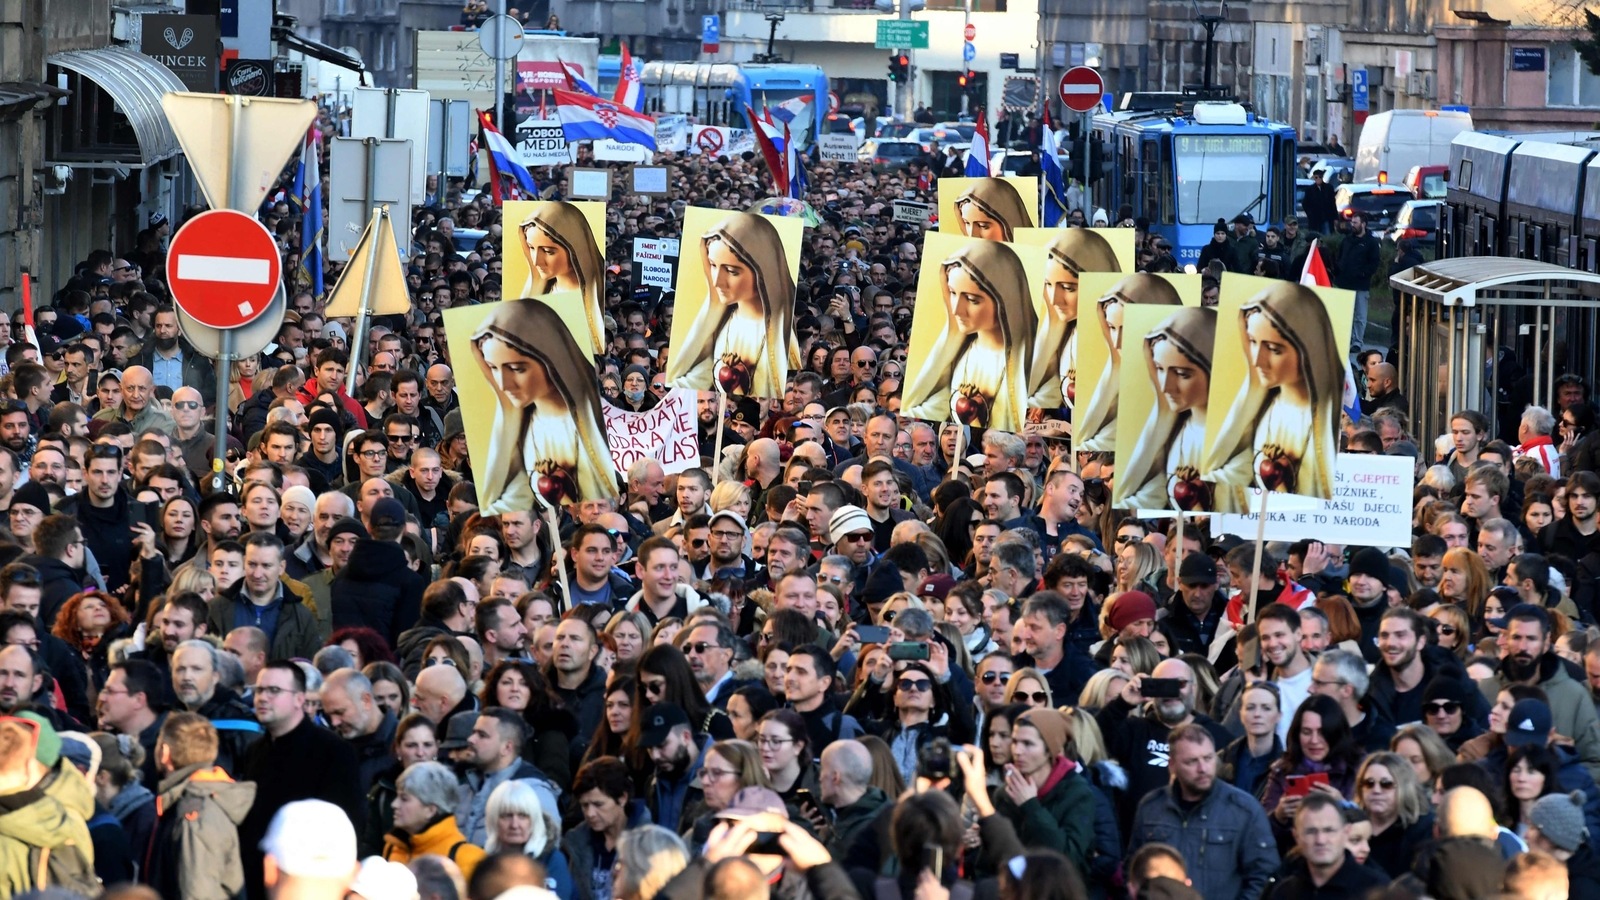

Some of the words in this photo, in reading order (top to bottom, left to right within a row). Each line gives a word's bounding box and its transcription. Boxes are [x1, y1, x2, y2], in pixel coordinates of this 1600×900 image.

[1181, 138, 1189, 153] 9
[821, 151, 846, 160] Nicht
[901, 206, 923, 216] MJERE?
[1180, 249, 1201, 258] 336
[608, 433, 650, 450] ODA,
[1335, 473, 1350, 484] ŠI,
[1353, 474, 1400, 486] CJEPITE
[1324, 499, 1355, 511] NAŠU
[1364, 503, 1403, 515] DJECU.
[1292, 514, 1307, 523] JE
[1313, 515, 1328, 524] TO
[1333, 516, 1381, 528] NARODA
